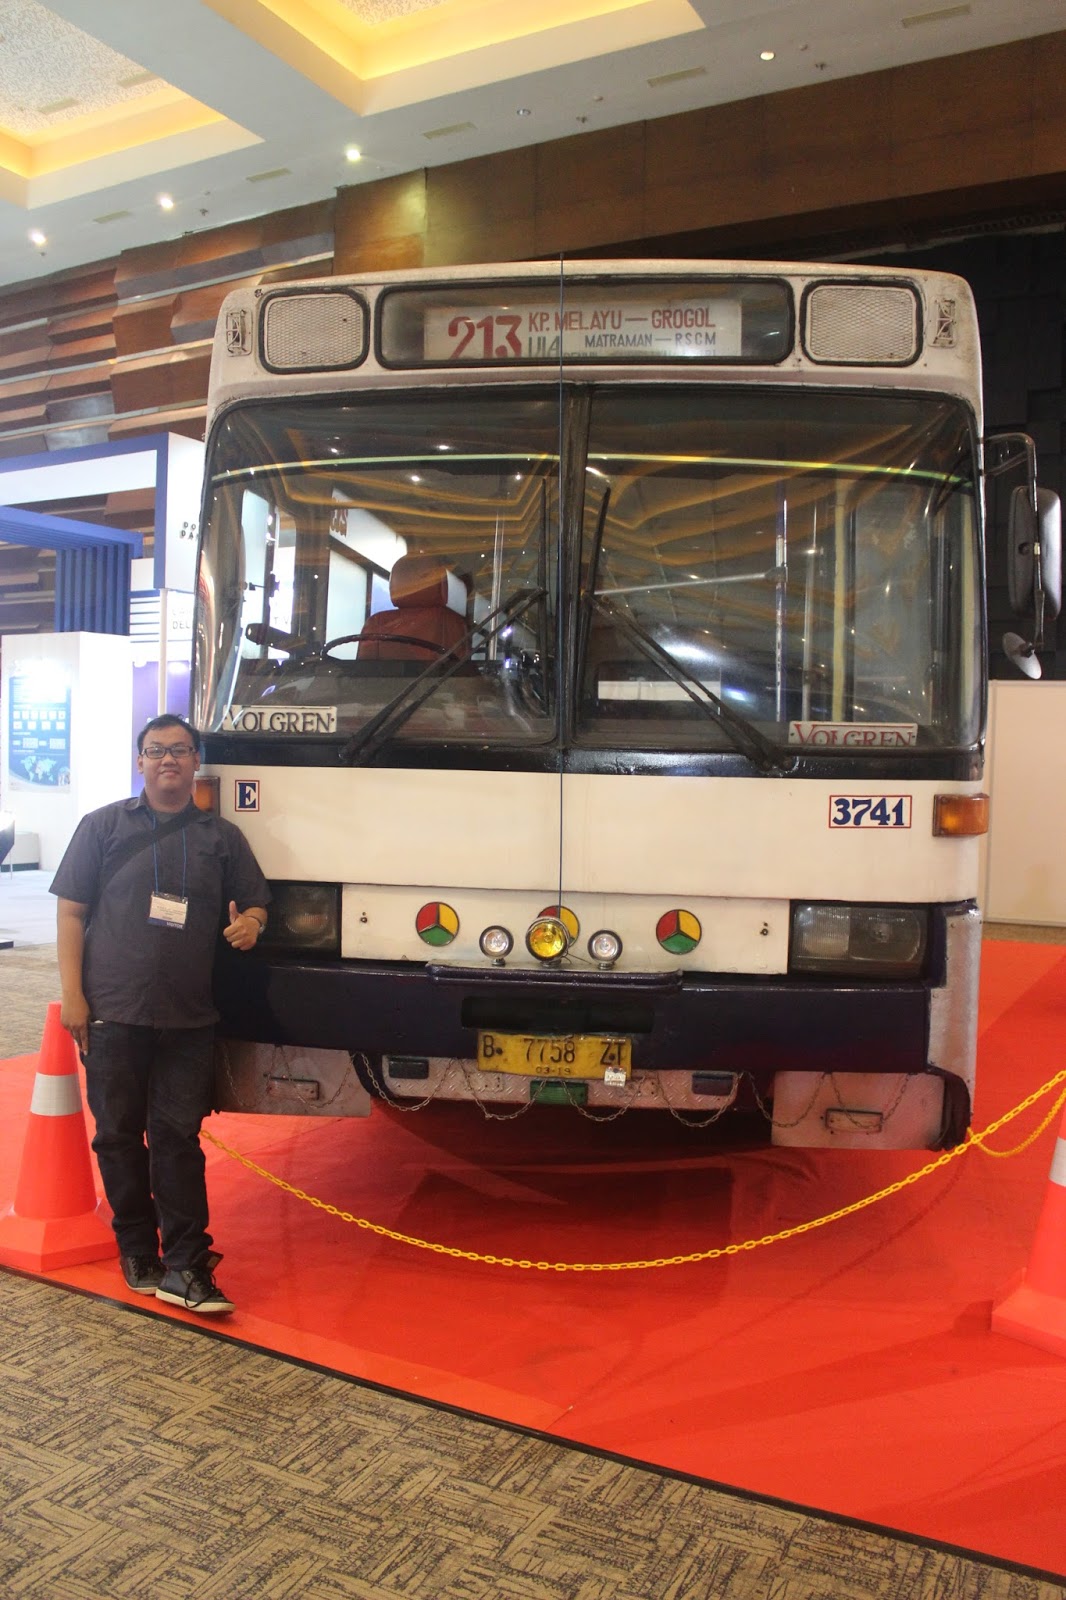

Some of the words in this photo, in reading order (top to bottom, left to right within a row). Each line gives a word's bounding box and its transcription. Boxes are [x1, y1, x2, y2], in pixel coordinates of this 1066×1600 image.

[651, 307, 716, 329] GROGOL
[447, 315, 522, 359] 213
[585, 333, 653, 348] MATRAMAN
[228, 706, 332, 733] VOLGREN
[238, 782, 256, 809] E
[832, 797, 905, 826] 3741
[483, 1035, 495, 1058] B
[523, 1037, 576, 1063] 7758
[600, 1040, 626, 1066] ZT
[535, 1066, 571, 1075] 03-19
